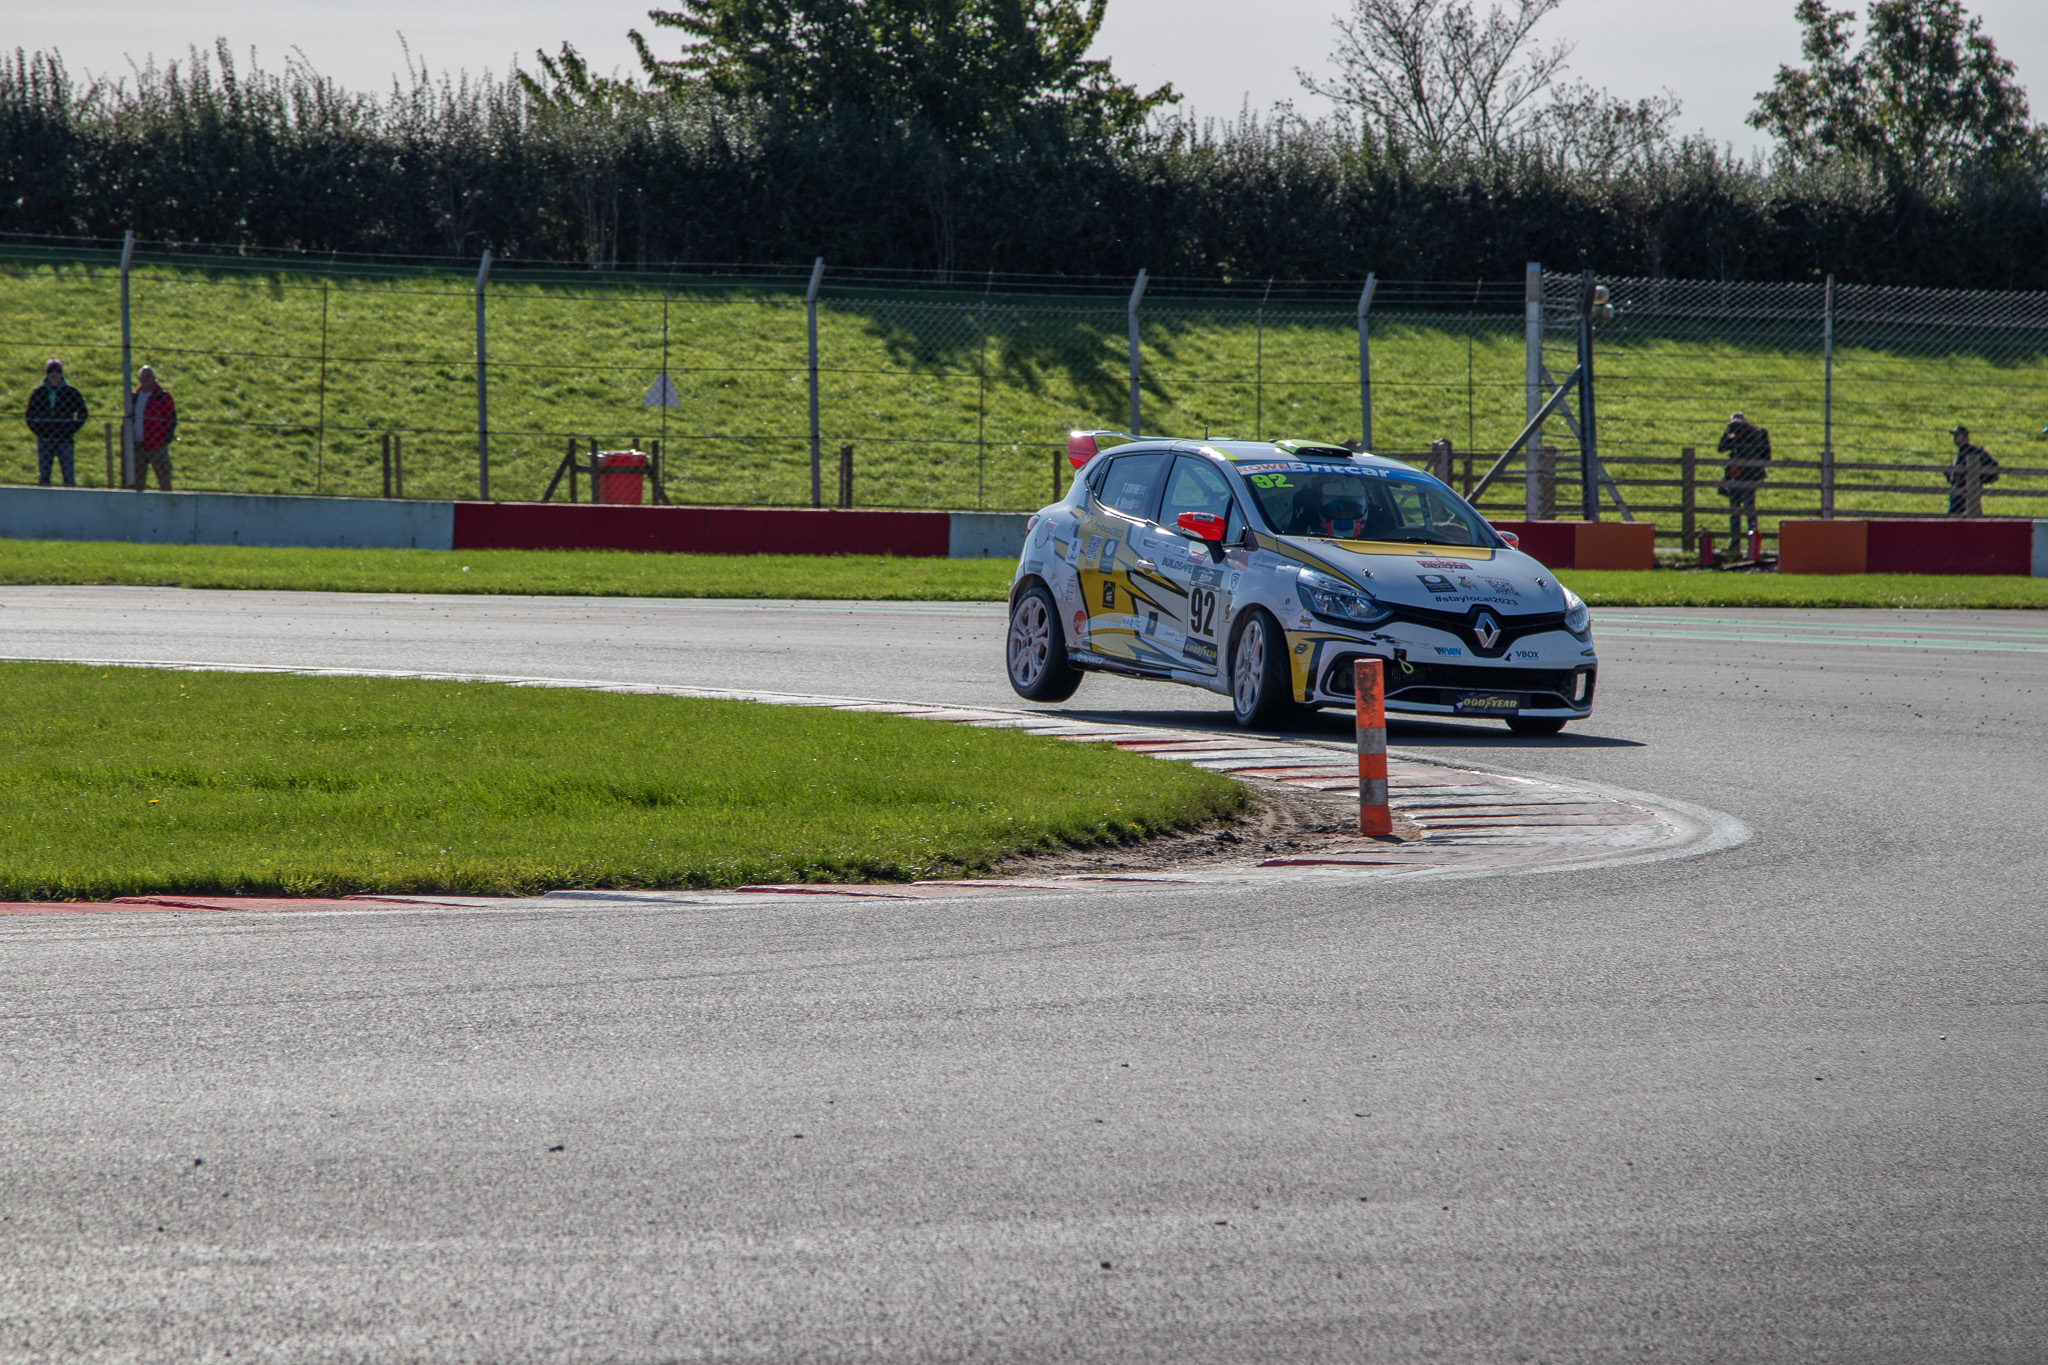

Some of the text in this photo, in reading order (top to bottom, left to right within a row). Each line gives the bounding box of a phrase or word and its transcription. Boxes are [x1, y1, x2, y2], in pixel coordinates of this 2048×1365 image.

[1238, 463, 1287, 472] ROWE
[1289, 462, 1389, 477] Britcar
[1251, 473, 1294, 489] 92
[1435, 595, 1518, 606] #staylocal2023
[1190, 588, 1215, 637] 92
[1184, 645, 1217, 659] GOODYEAR
[1463, 697, 1517, 709] OODYEAR
